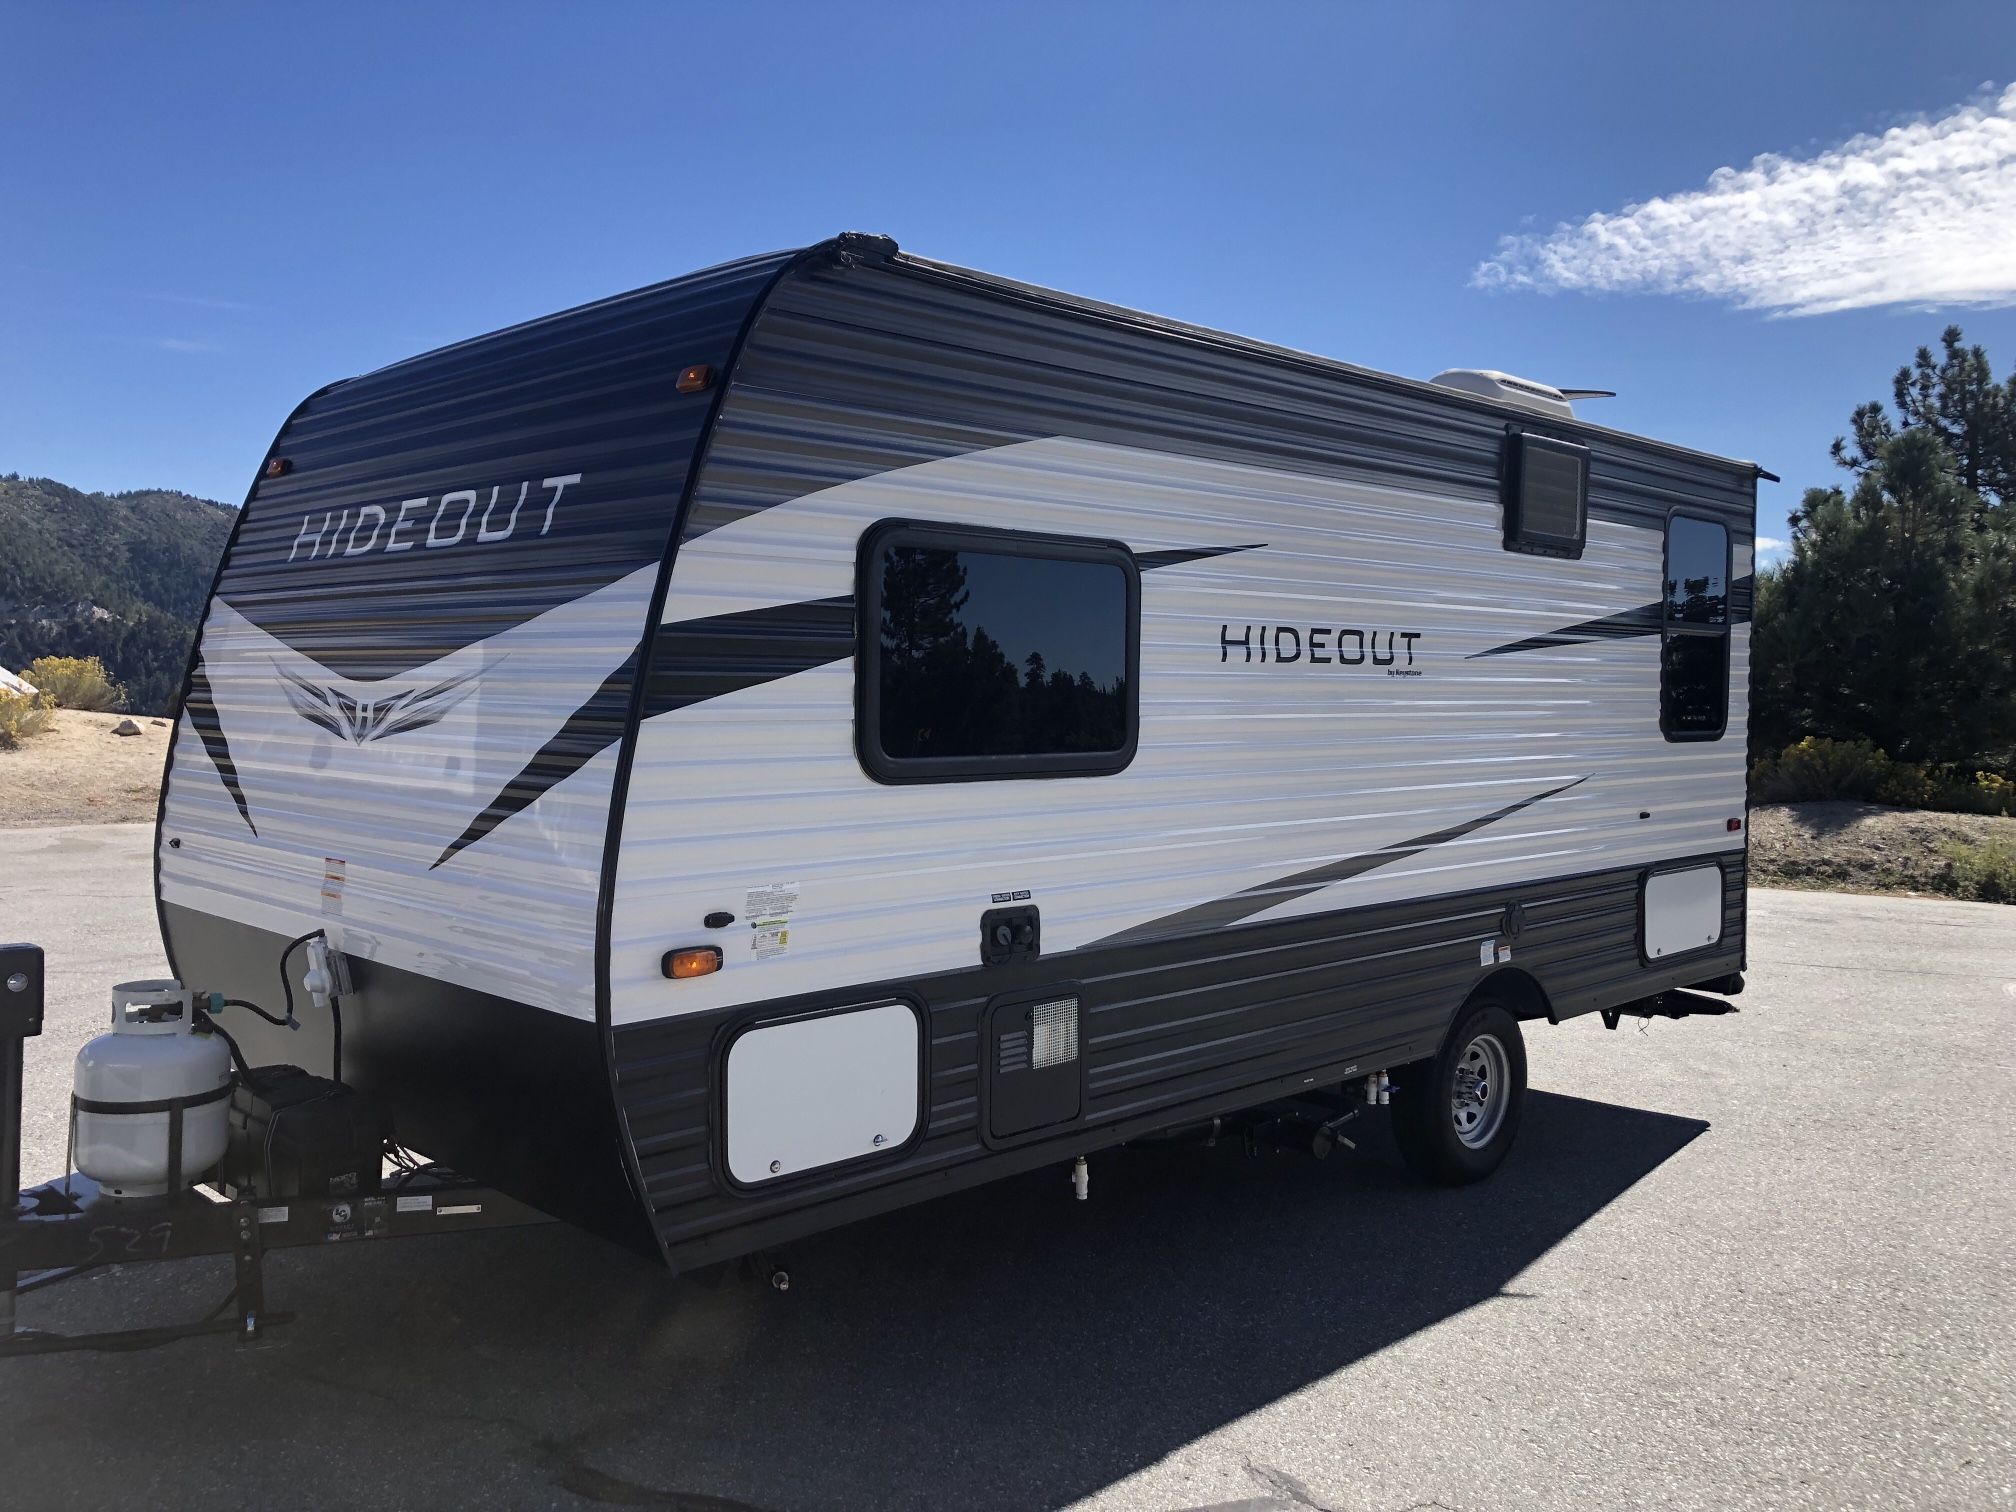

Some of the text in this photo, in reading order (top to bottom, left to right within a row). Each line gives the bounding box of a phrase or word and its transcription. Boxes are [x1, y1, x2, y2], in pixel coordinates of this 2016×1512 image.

[287, 473, 582, 562] HIDEOUT
[1221, 625, 1421, 665] HIDEOUT
[1387, 669, 1395, 677] by
